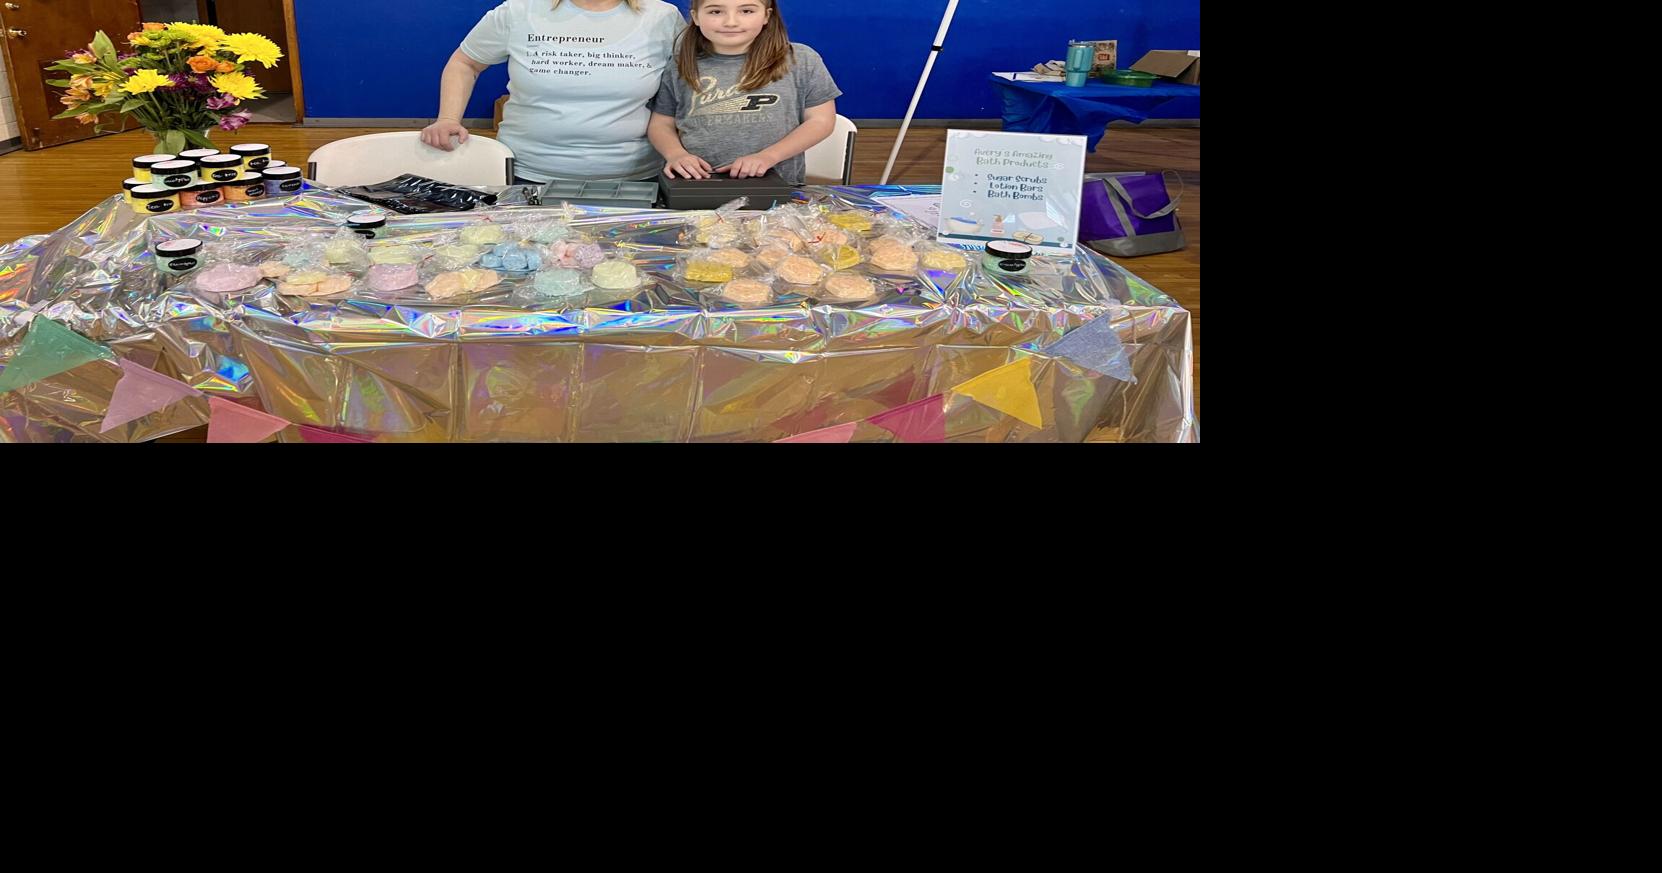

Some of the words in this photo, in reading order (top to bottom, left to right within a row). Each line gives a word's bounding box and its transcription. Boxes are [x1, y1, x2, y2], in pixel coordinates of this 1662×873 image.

[527, 34, 605, 44] Entrepreneur
[587, 51, 600, 59] big
[603, 52, 636, 60] thinker,
[740, 93, 780, 112] P
[1012, 150, 1053, 160] Amazing
[976, 156, 1000, 165] Bath
[1002, 158, 1049, 168] Products
[987, 173, 1014, 181] Sugar
[1015, 175, 1048, 184] Scrubs
[989, 182, 1018, 190] Lotion
[1020, 183, 1044, 192] Bars
[987, 190, 1011, 198] Bath
[1012, 191, 1044, 201] Bombs
